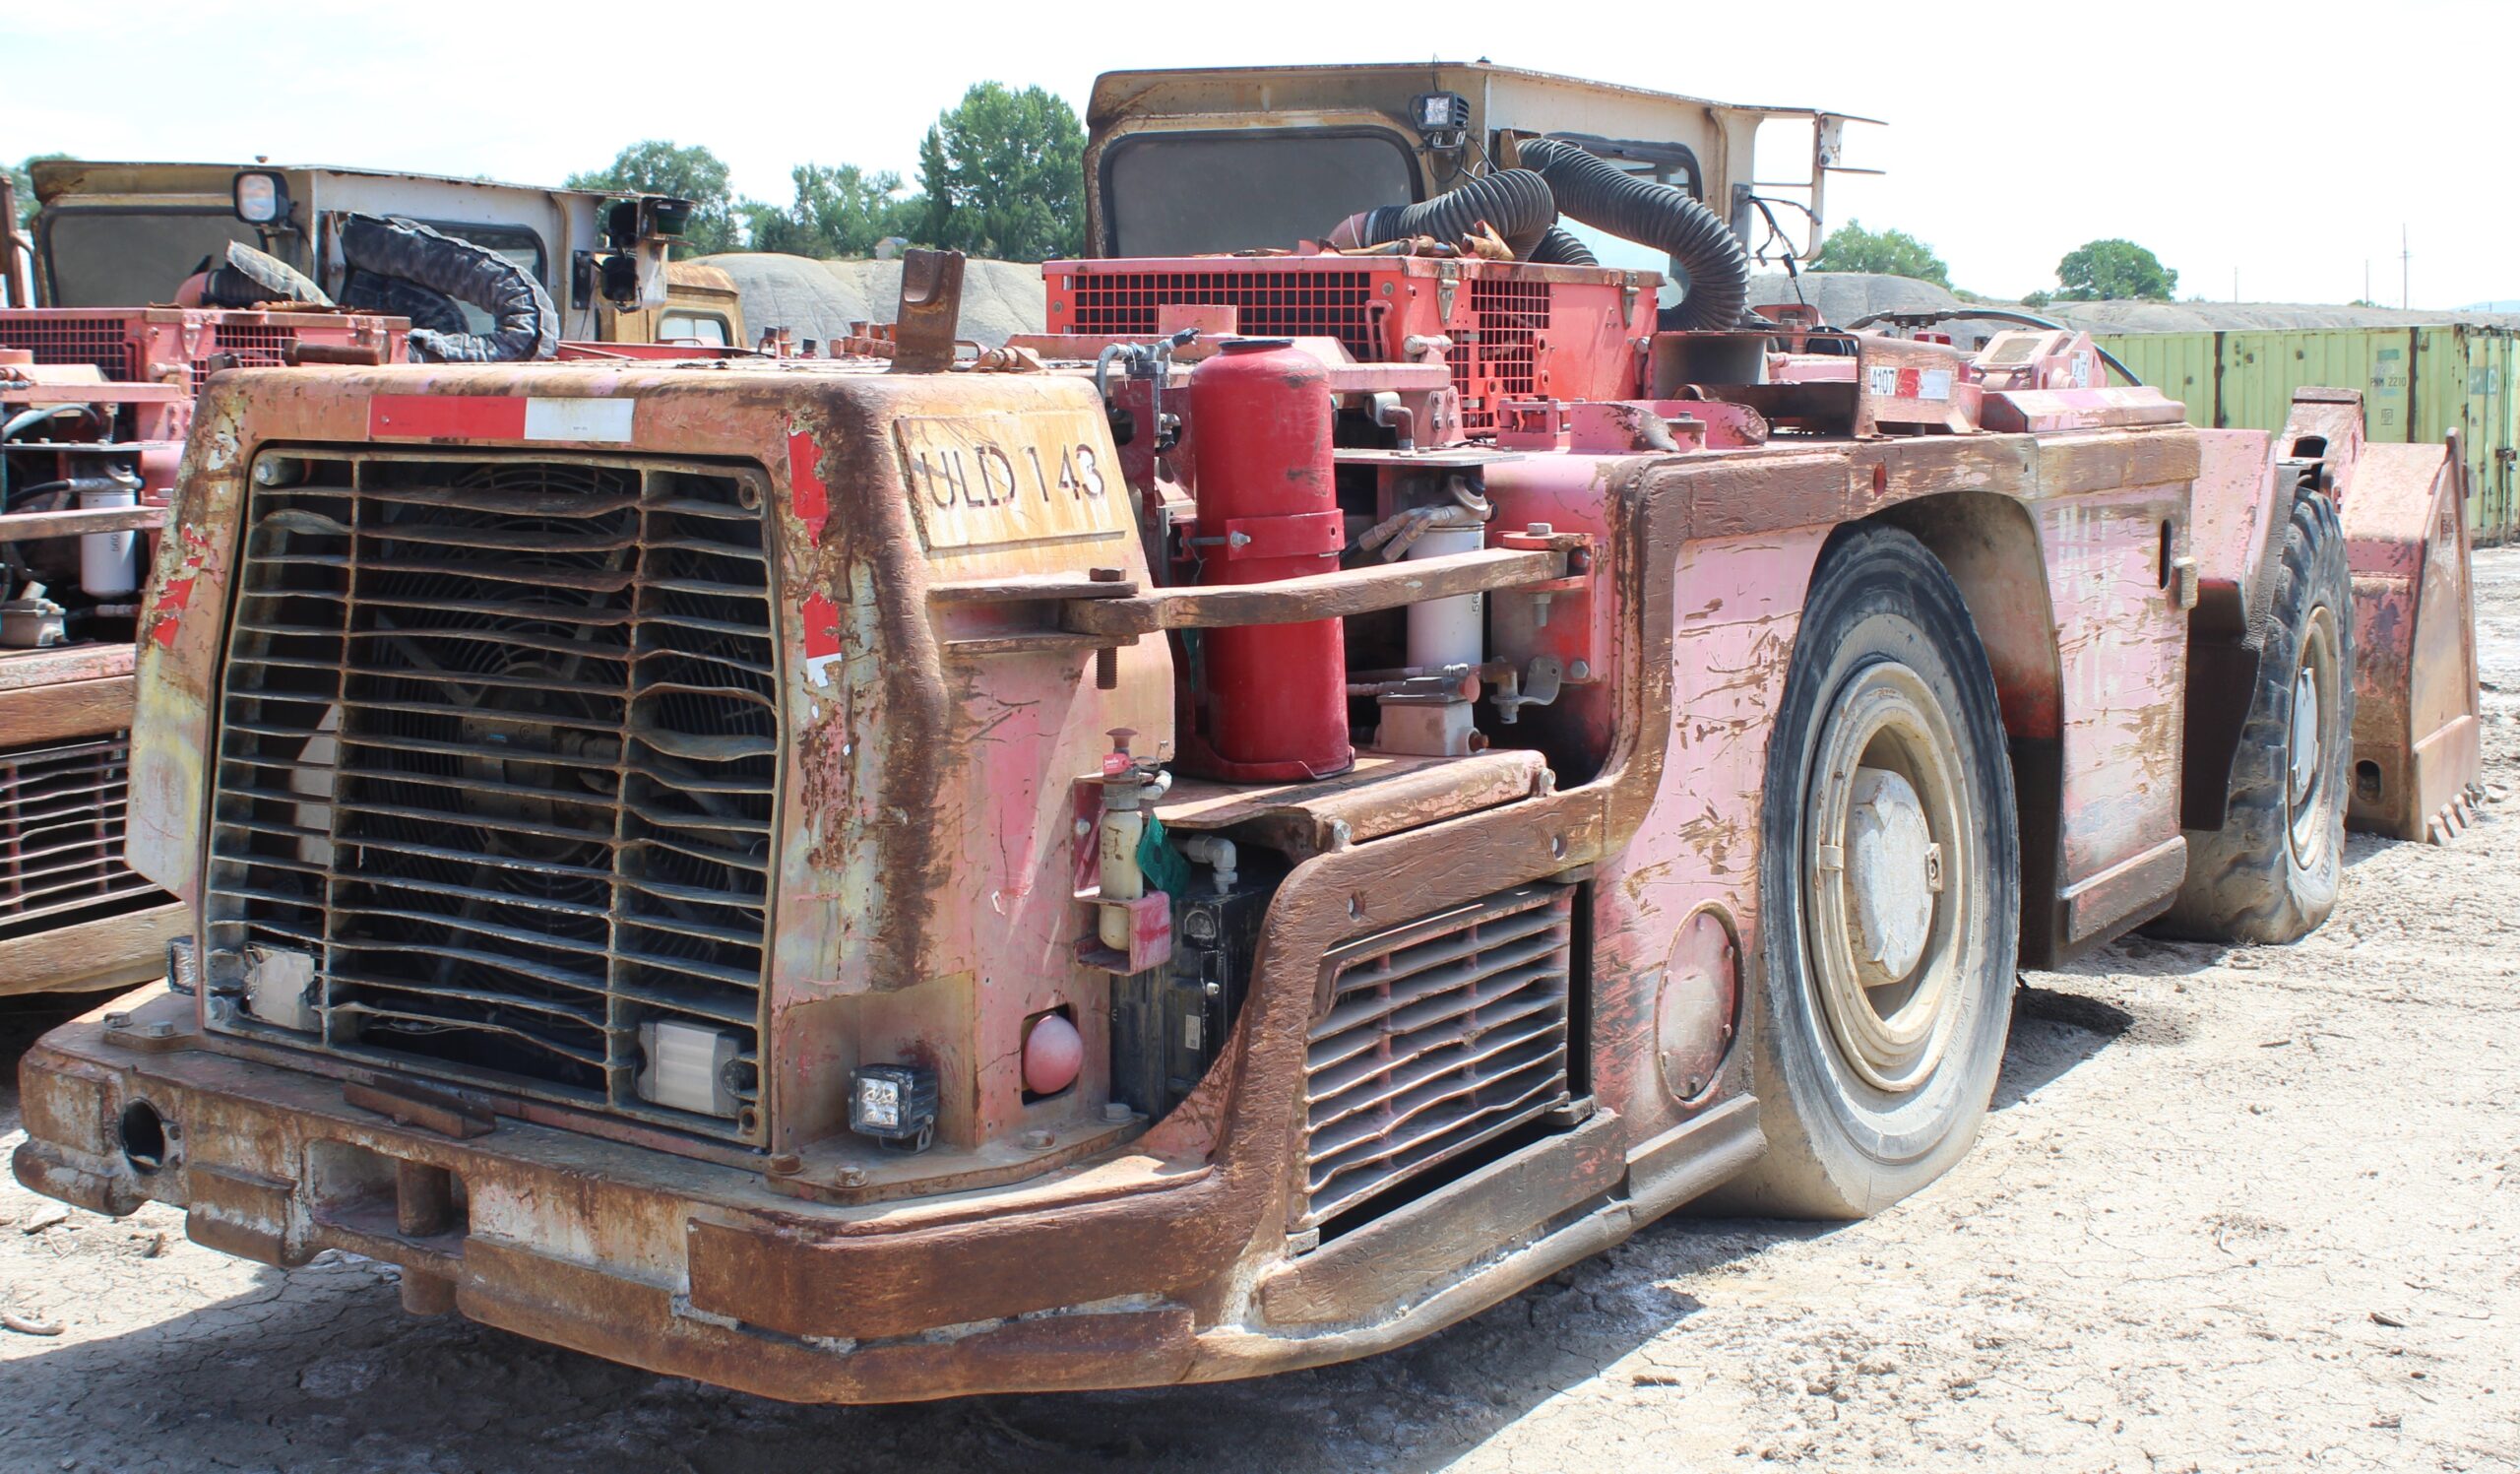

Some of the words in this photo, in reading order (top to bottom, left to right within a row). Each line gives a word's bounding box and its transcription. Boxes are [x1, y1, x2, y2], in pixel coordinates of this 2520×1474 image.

[1870, 368, 1895, 395] 4107
[2388, 376, 2407, 387] 2210
[919, 443, 1016, 509] ULD
[1025, 442, 1105, 503] 143
